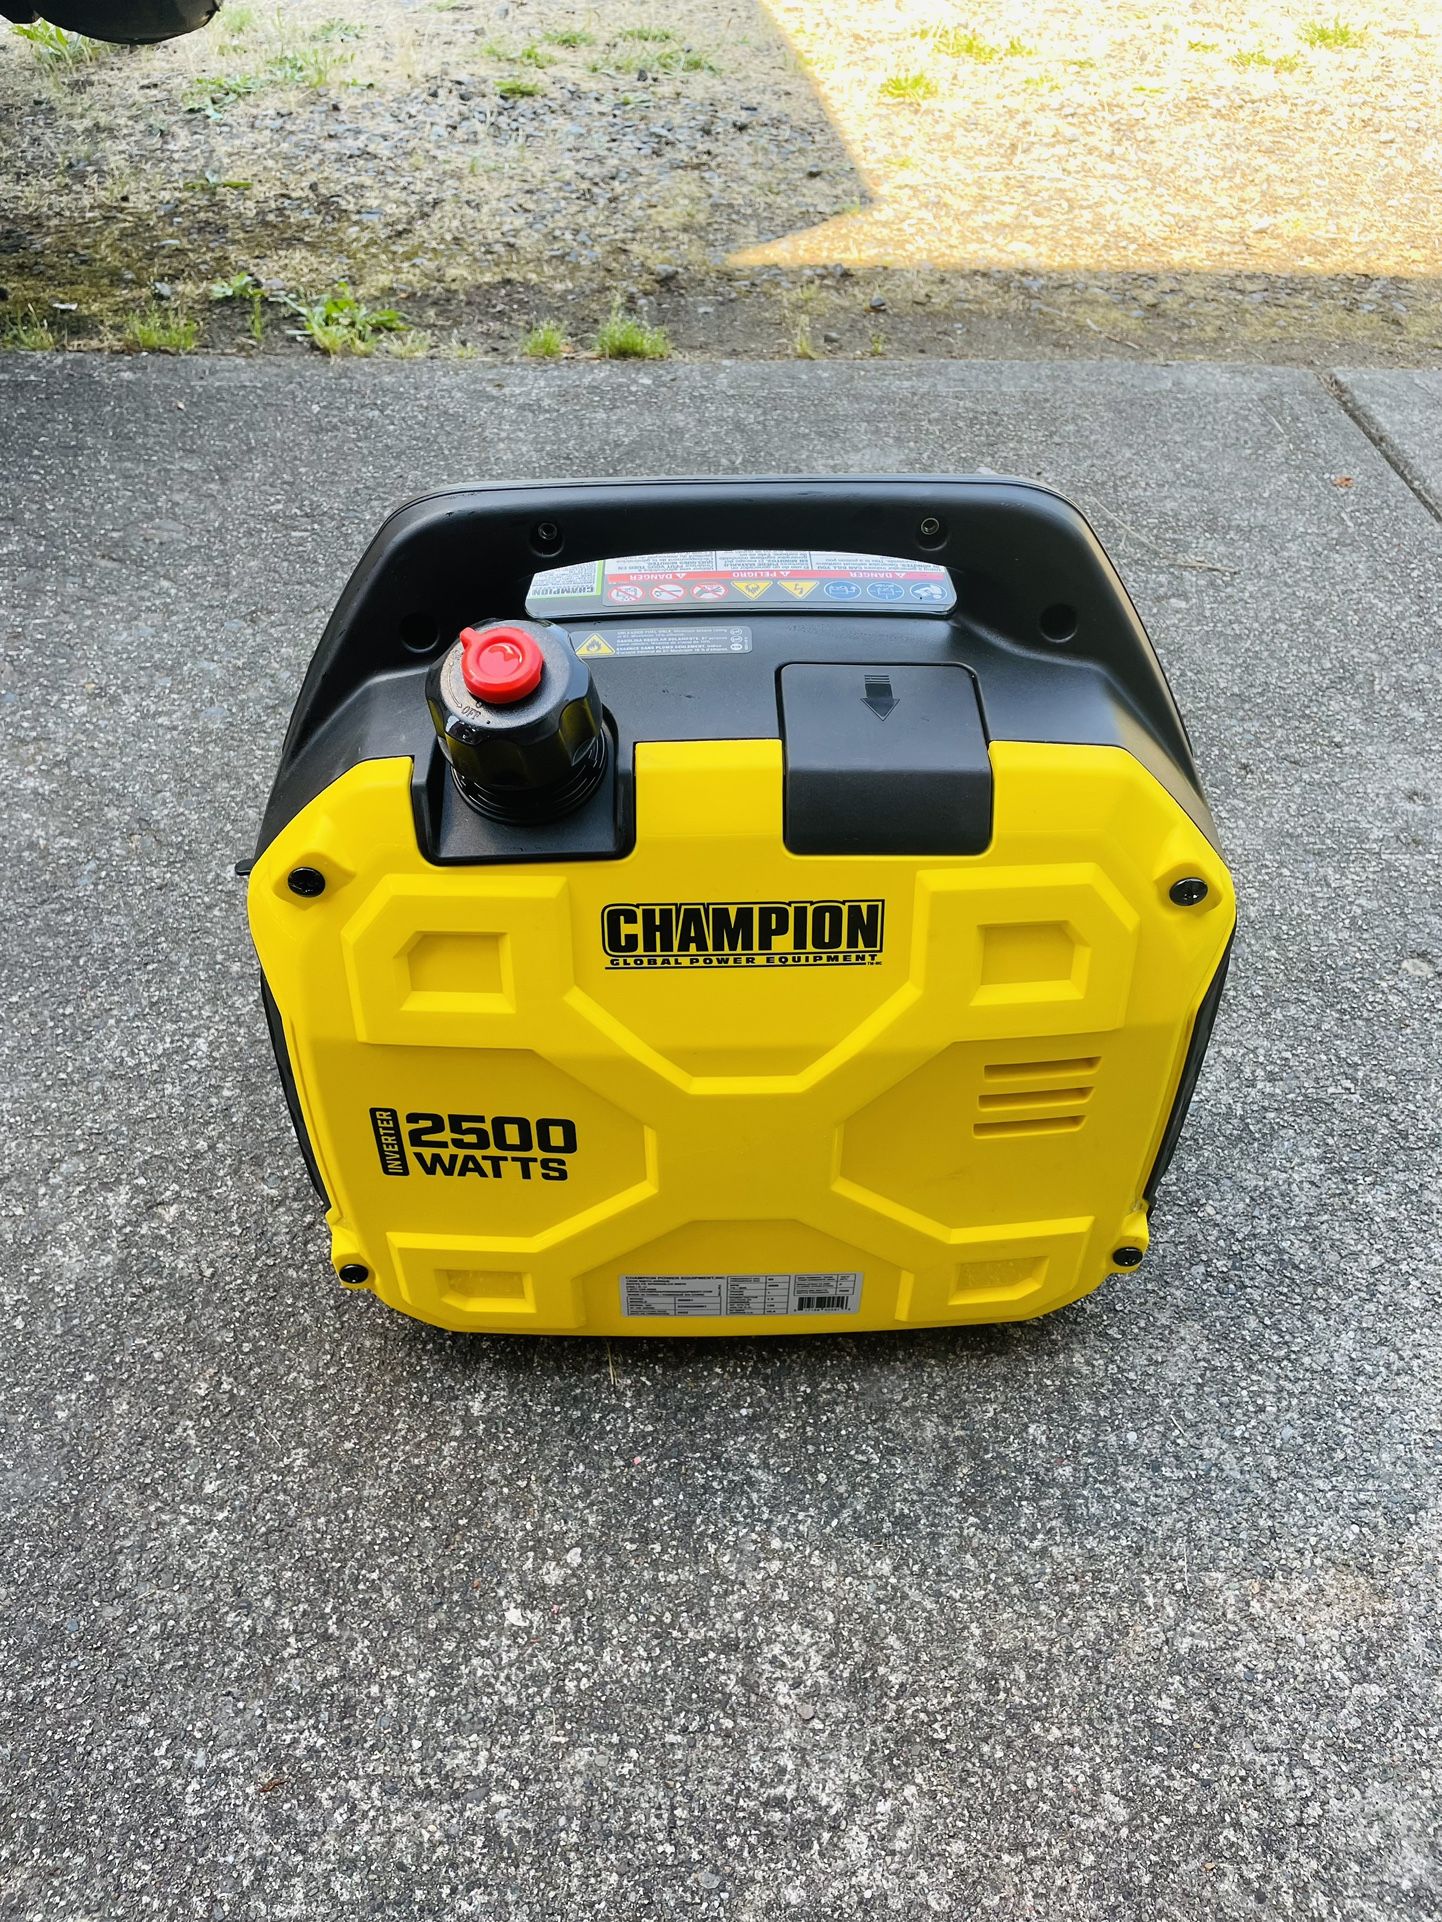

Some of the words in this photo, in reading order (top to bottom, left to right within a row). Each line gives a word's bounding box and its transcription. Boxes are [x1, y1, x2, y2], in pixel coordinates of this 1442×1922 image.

[532, 585, 595, 596] CHAMPION
[461, 705, 481, 720] OFF
[604, 902, 882, 955] CHAMPION
[609, 956, 683, 967] GLOBAL
[689, 956, 756, 966] POWER
[765, 953, 878, 965] EQUIPMENT
[375, 1110, 404, 1174] INVERTER
[405, 1111, 578, 1155] 2500
[412, 1151, 568, 1182] WATTS
